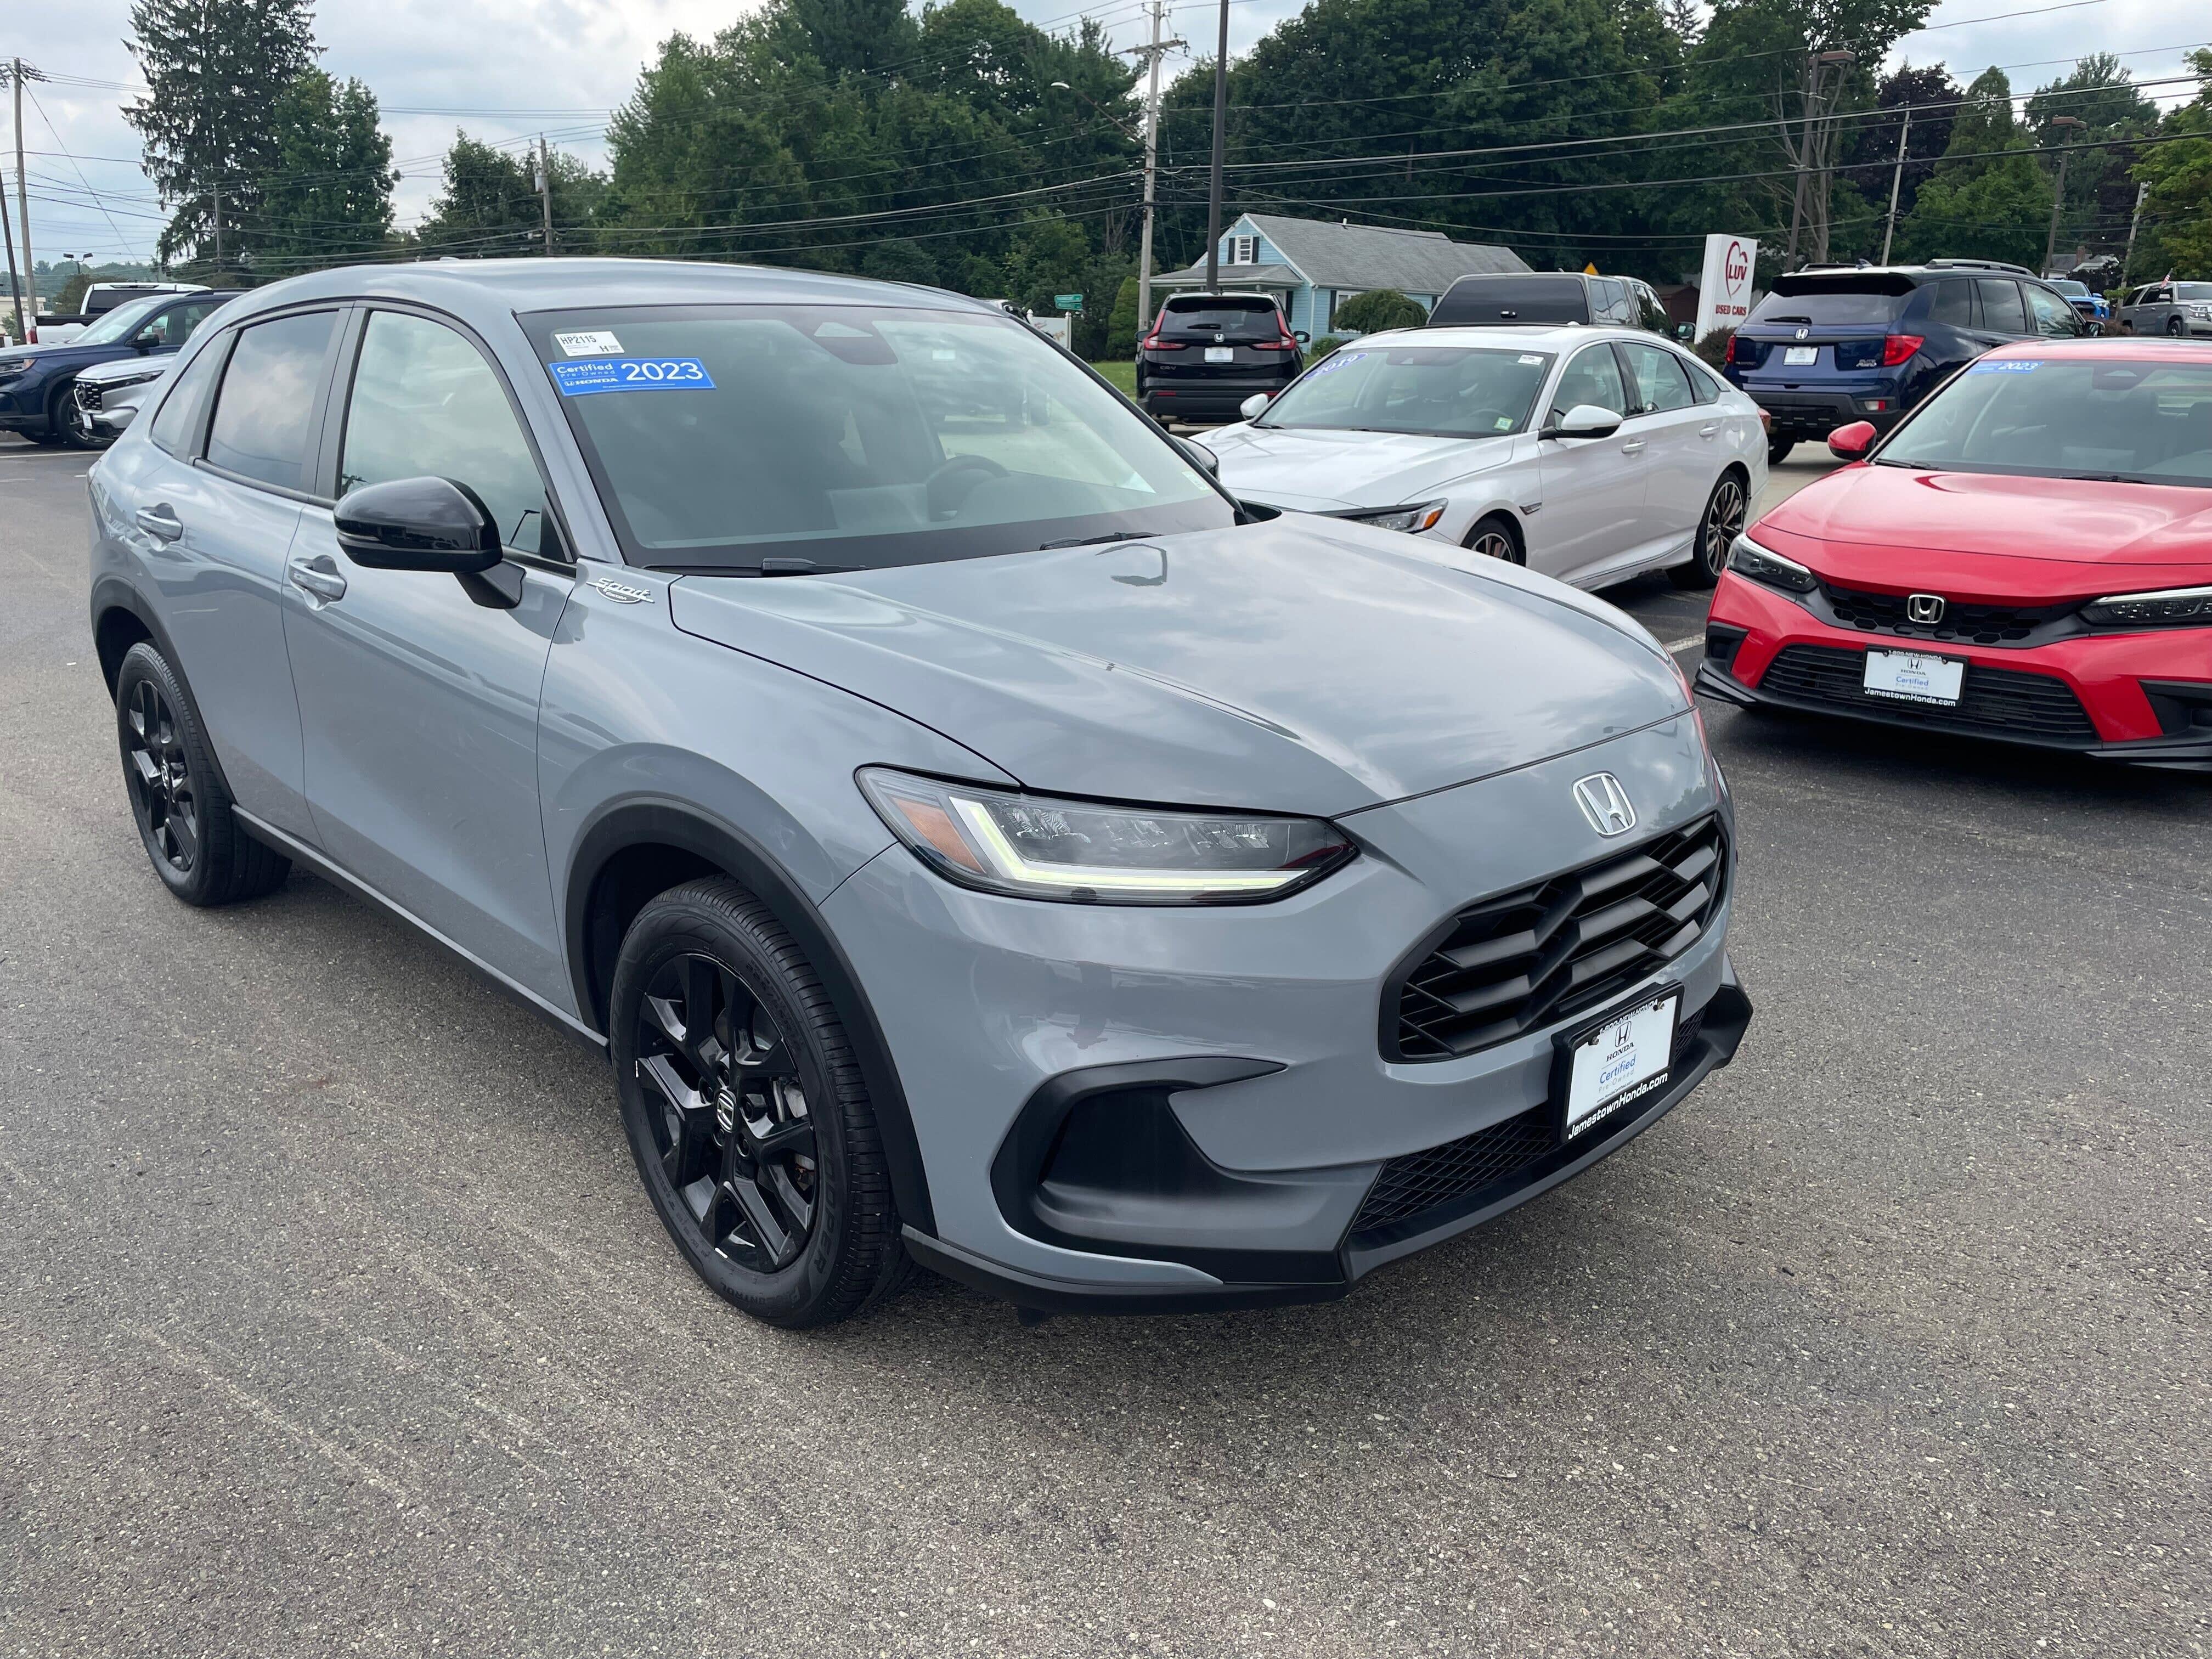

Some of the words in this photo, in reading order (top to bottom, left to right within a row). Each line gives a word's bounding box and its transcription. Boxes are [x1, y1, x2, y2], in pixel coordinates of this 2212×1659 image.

[1729, 264, 1747, 280] LUV
[1716, 304, 1730, 314] USED
[1732, 306, 1747, 316] CARS
[560, 335, 596, 345] HP2115
[557, 363, 613, 373] Certified
[620, 362, 704, 381] 2023
[1997, 362, 2039, 370] 2023
[1896, 676, 1929, 686] Certified
[1864, 687, 1956, 707] JamestownHonda.com
[1606, 1042, 1634, 1062] HONDA
[1600, 1053, 1636, 1084] Certified
[1568, 1072, 1668, 1140] JamestownHonda.com
